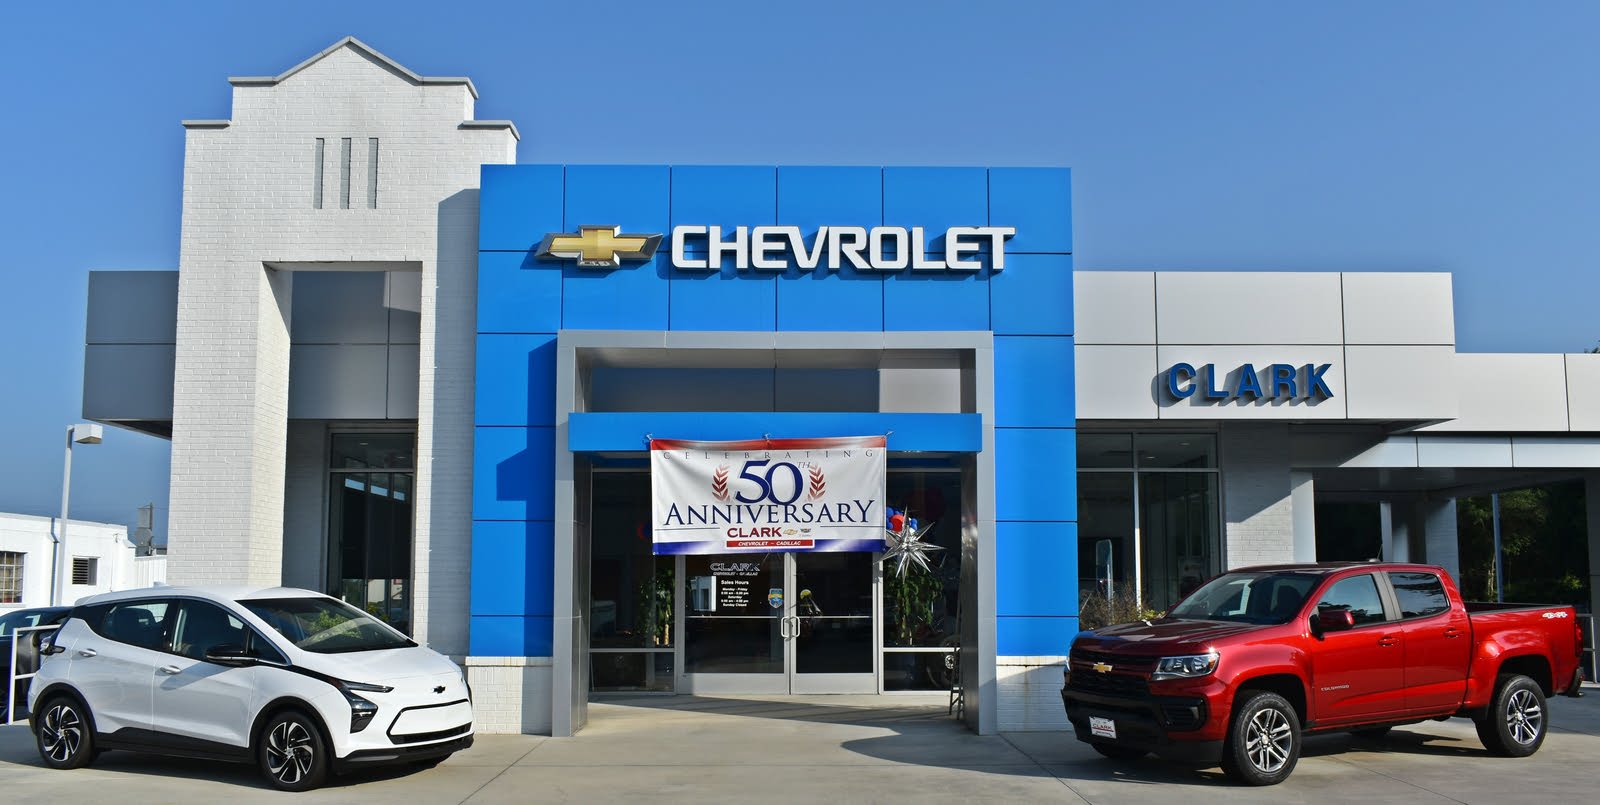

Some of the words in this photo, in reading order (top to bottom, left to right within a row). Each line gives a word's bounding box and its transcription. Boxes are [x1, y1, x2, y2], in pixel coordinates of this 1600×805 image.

[672, 225, 1016, 270] CHEVROLET
[1168, 362, 1334, 398] CLARK
[663, 449, 873, 460] CELEBRATING
[663, 499, 875, 526] ANNIVERSARY
[727, 527, 782, 538] CLARK
[709, 562, 760, 572] CLARK
